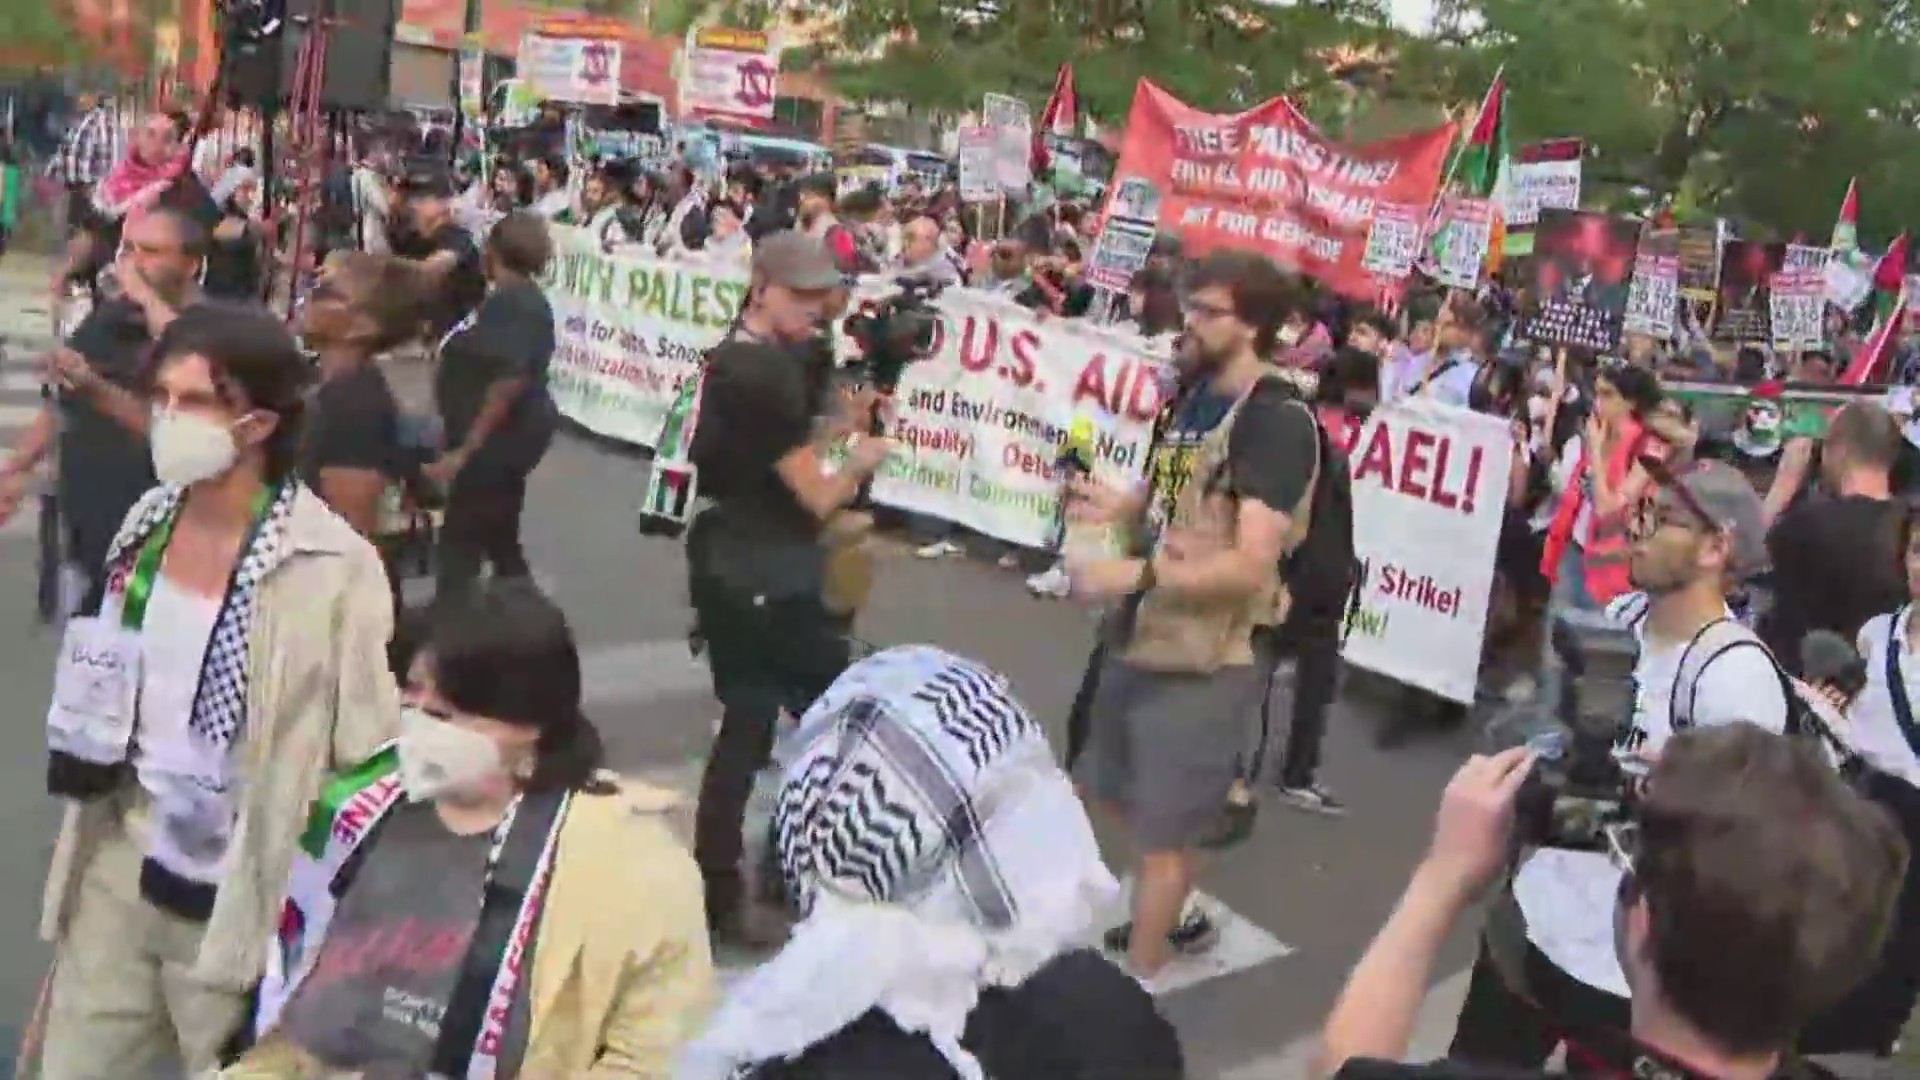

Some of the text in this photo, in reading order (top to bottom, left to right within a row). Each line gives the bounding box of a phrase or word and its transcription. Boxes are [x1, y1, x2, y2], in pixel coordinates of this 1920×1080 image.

[959, 315, 1045, 393] U.S.
[1073, 351, 1160, 424] AID
[895, 417, 1064, 480] Equality! Defe
[908, 388, 945, 414] and
[951, 391, 1068, 446] Environmen
